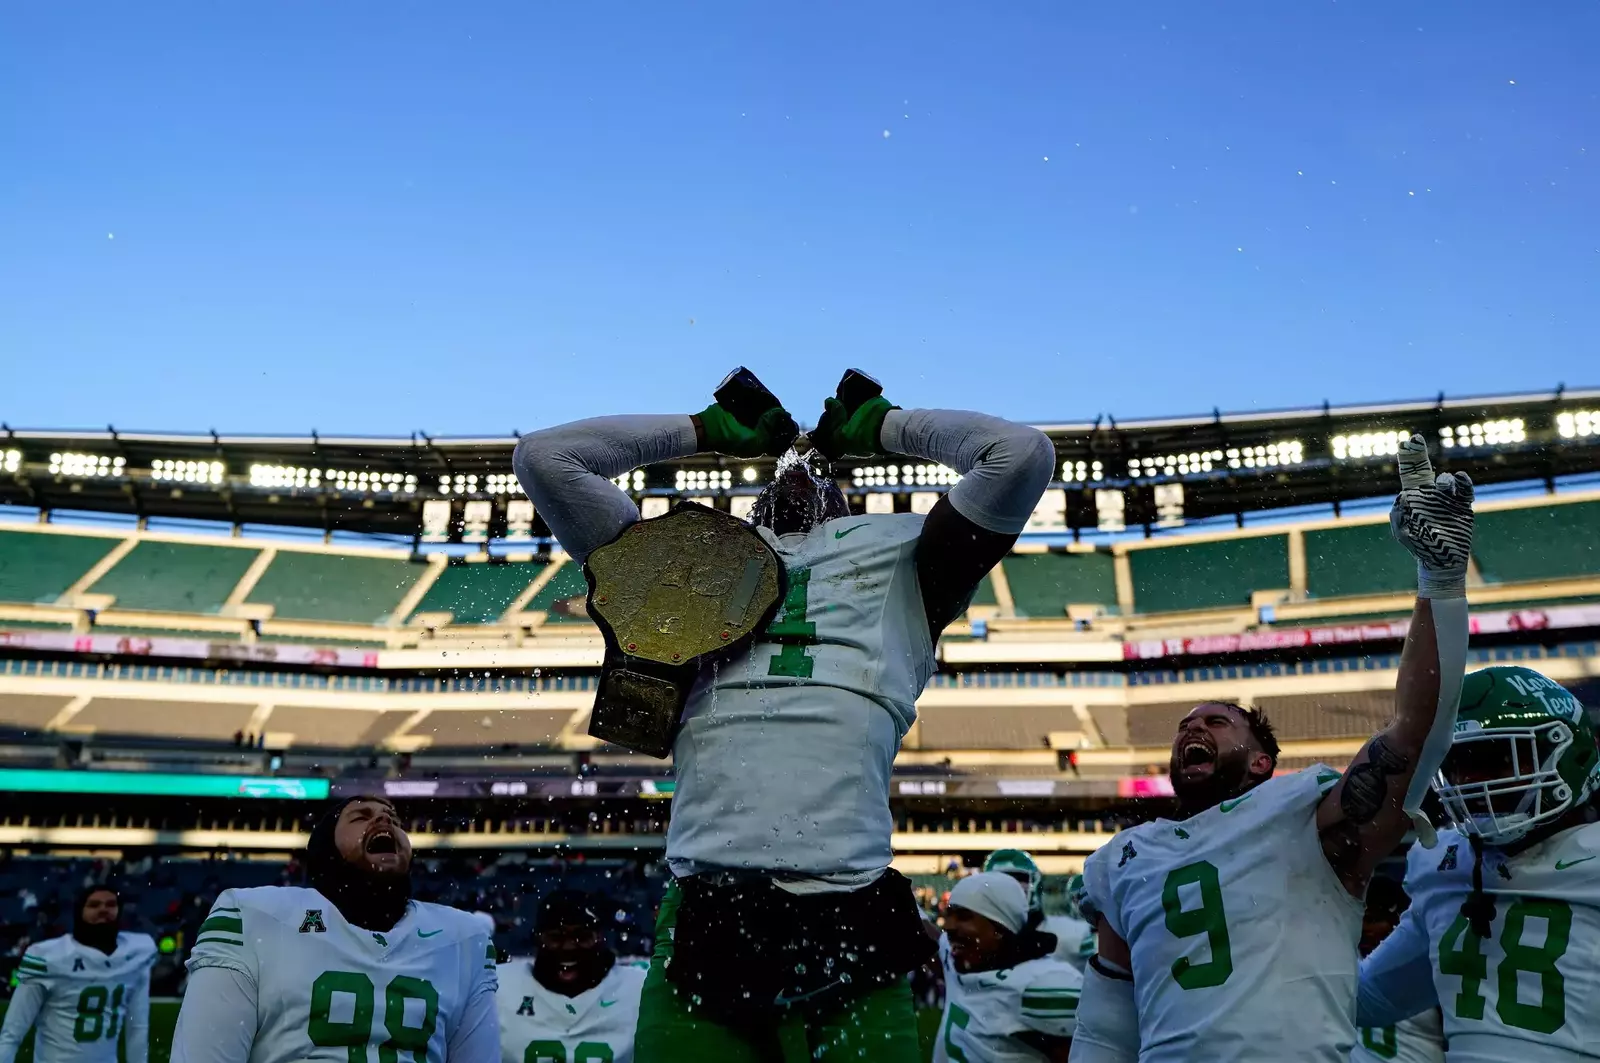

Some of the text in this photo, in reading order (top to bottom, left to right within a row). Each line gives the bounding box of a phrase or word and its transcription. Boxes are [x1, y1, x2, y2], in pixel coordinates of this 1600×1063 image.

[300, 909, 326, 932] A
[1161, 860, 1233, 990] 9
[73, 984, 125, 1042] 81
[1438, 901, 1573, 1035] 48
